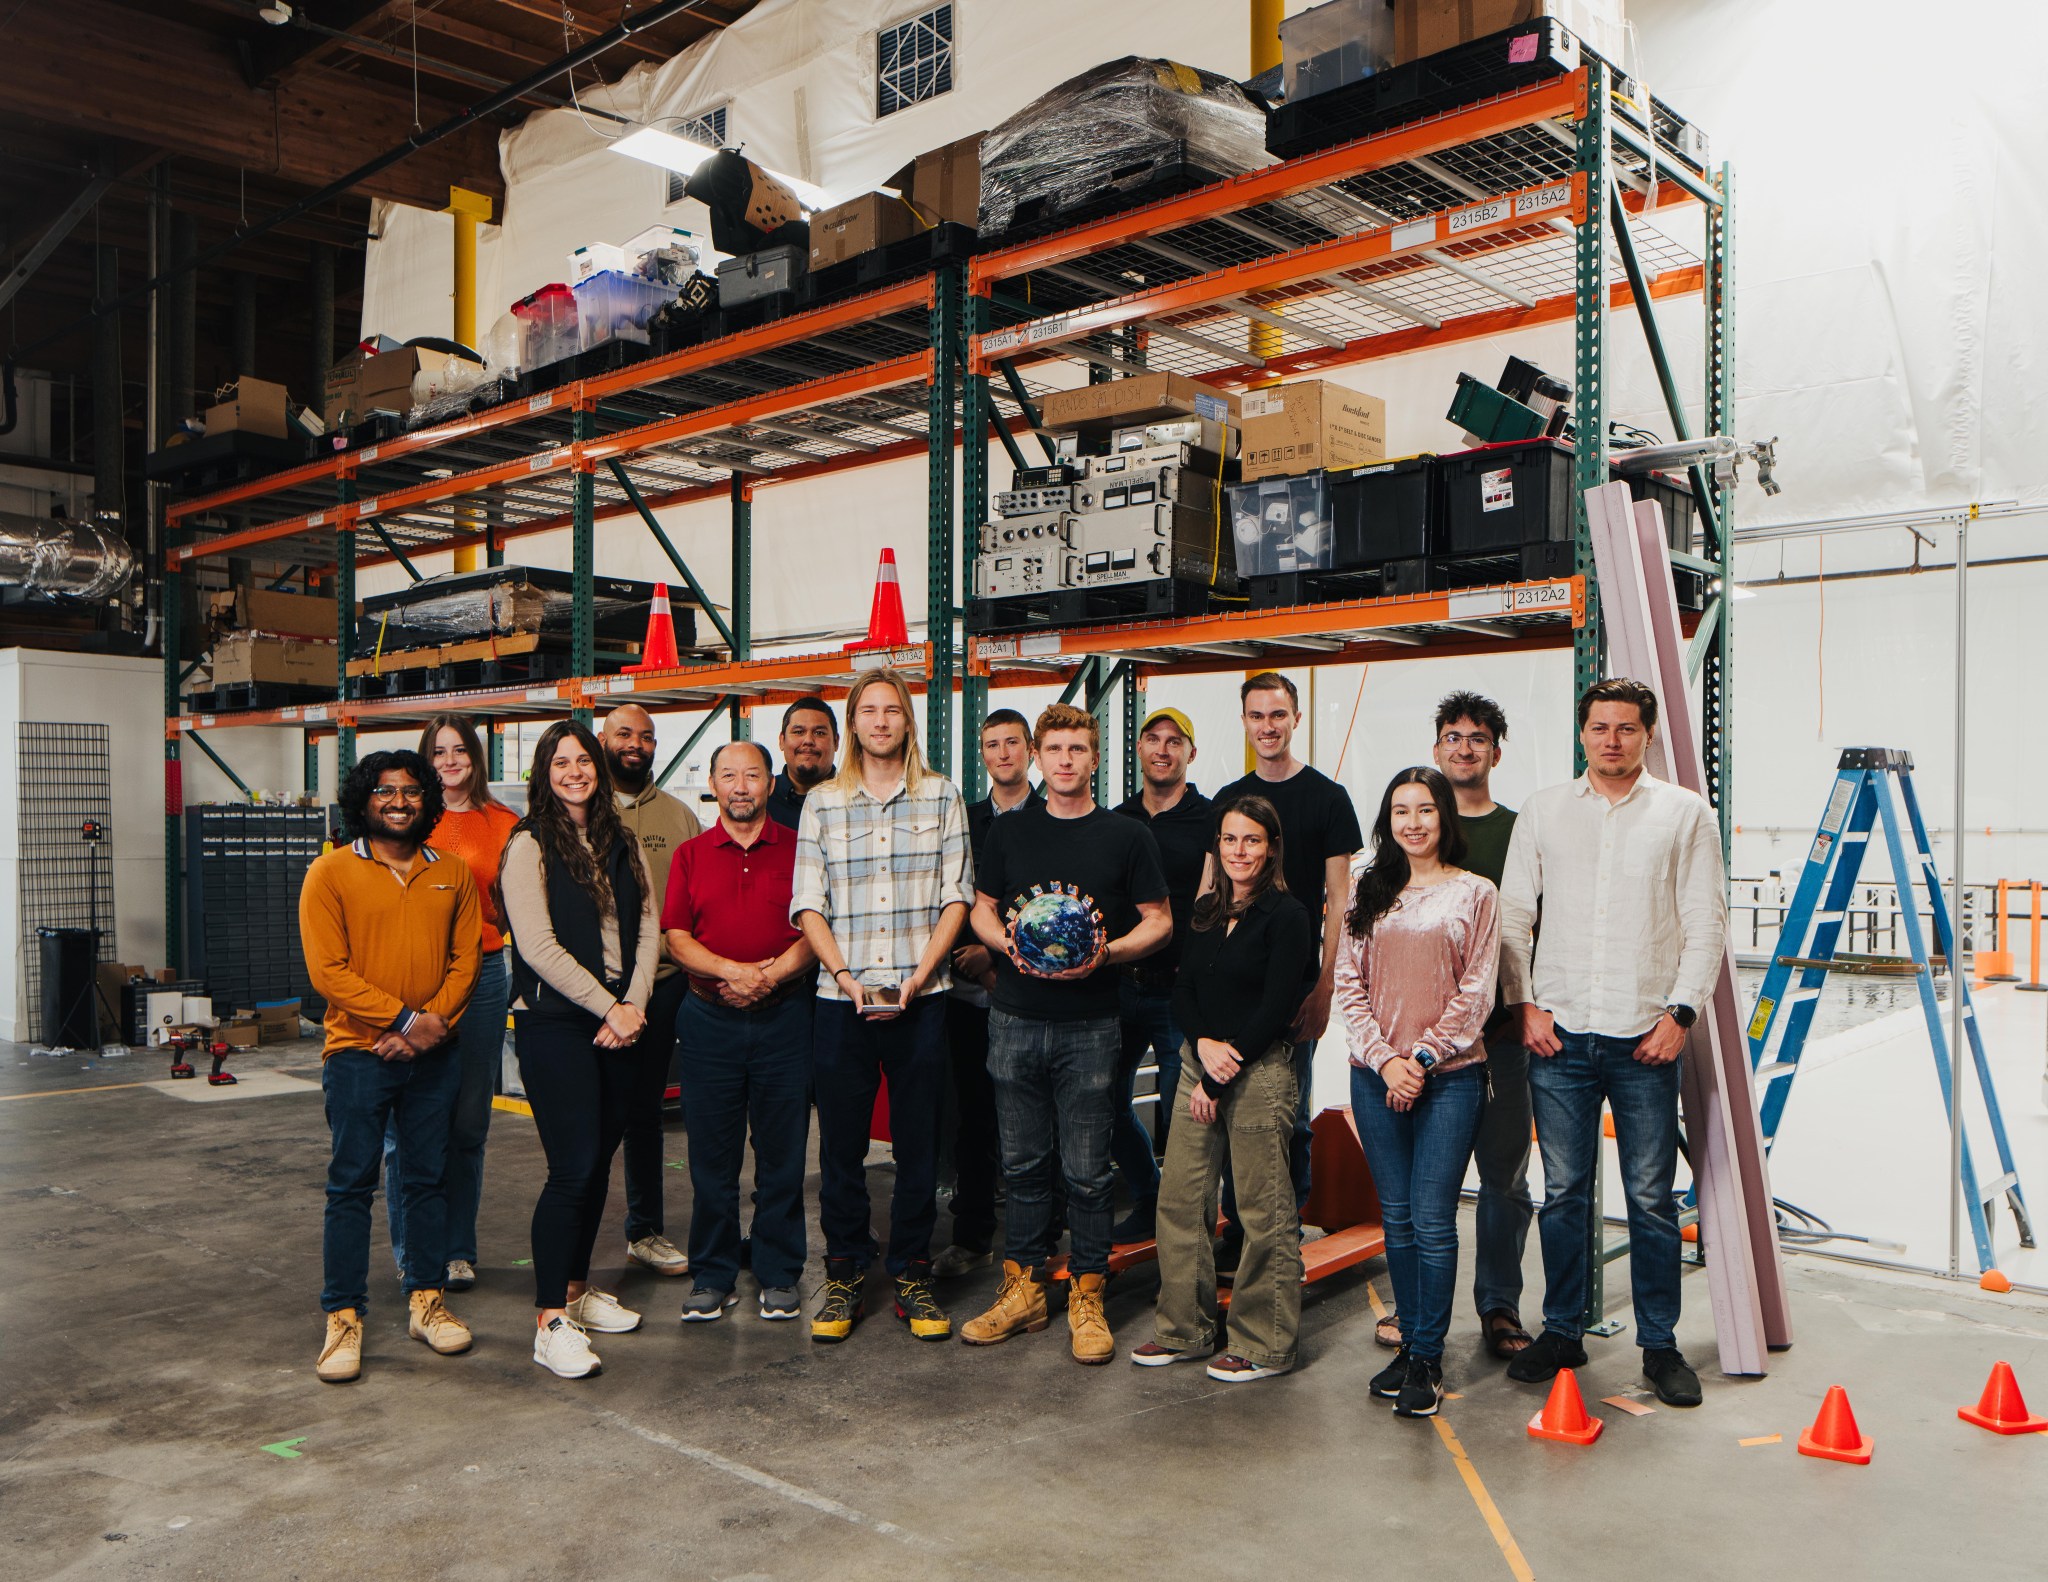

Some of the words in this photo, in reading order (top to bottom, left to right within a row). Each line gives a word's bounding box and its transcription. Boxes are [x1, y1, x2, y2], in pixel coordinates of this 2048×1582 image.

[1518, 188, 1566, 212] 2315A2
[1452, 206, 1499, 229] 2315B2
[1033, 322, 1063, 339] 2315B1
[983, 335, 1013, 350] 2315A1
[1114, 385, 1142, 407] DISH
[1109, 476, 1144, 489] SPELLMAN
[1096, 570, 1127, 581] SPELLMAN
[1517, 588, 1565, 604] 2312A2
[896, 650, 923, 662] 2313A2
[978, 644, 1007, 655] 2312A1
